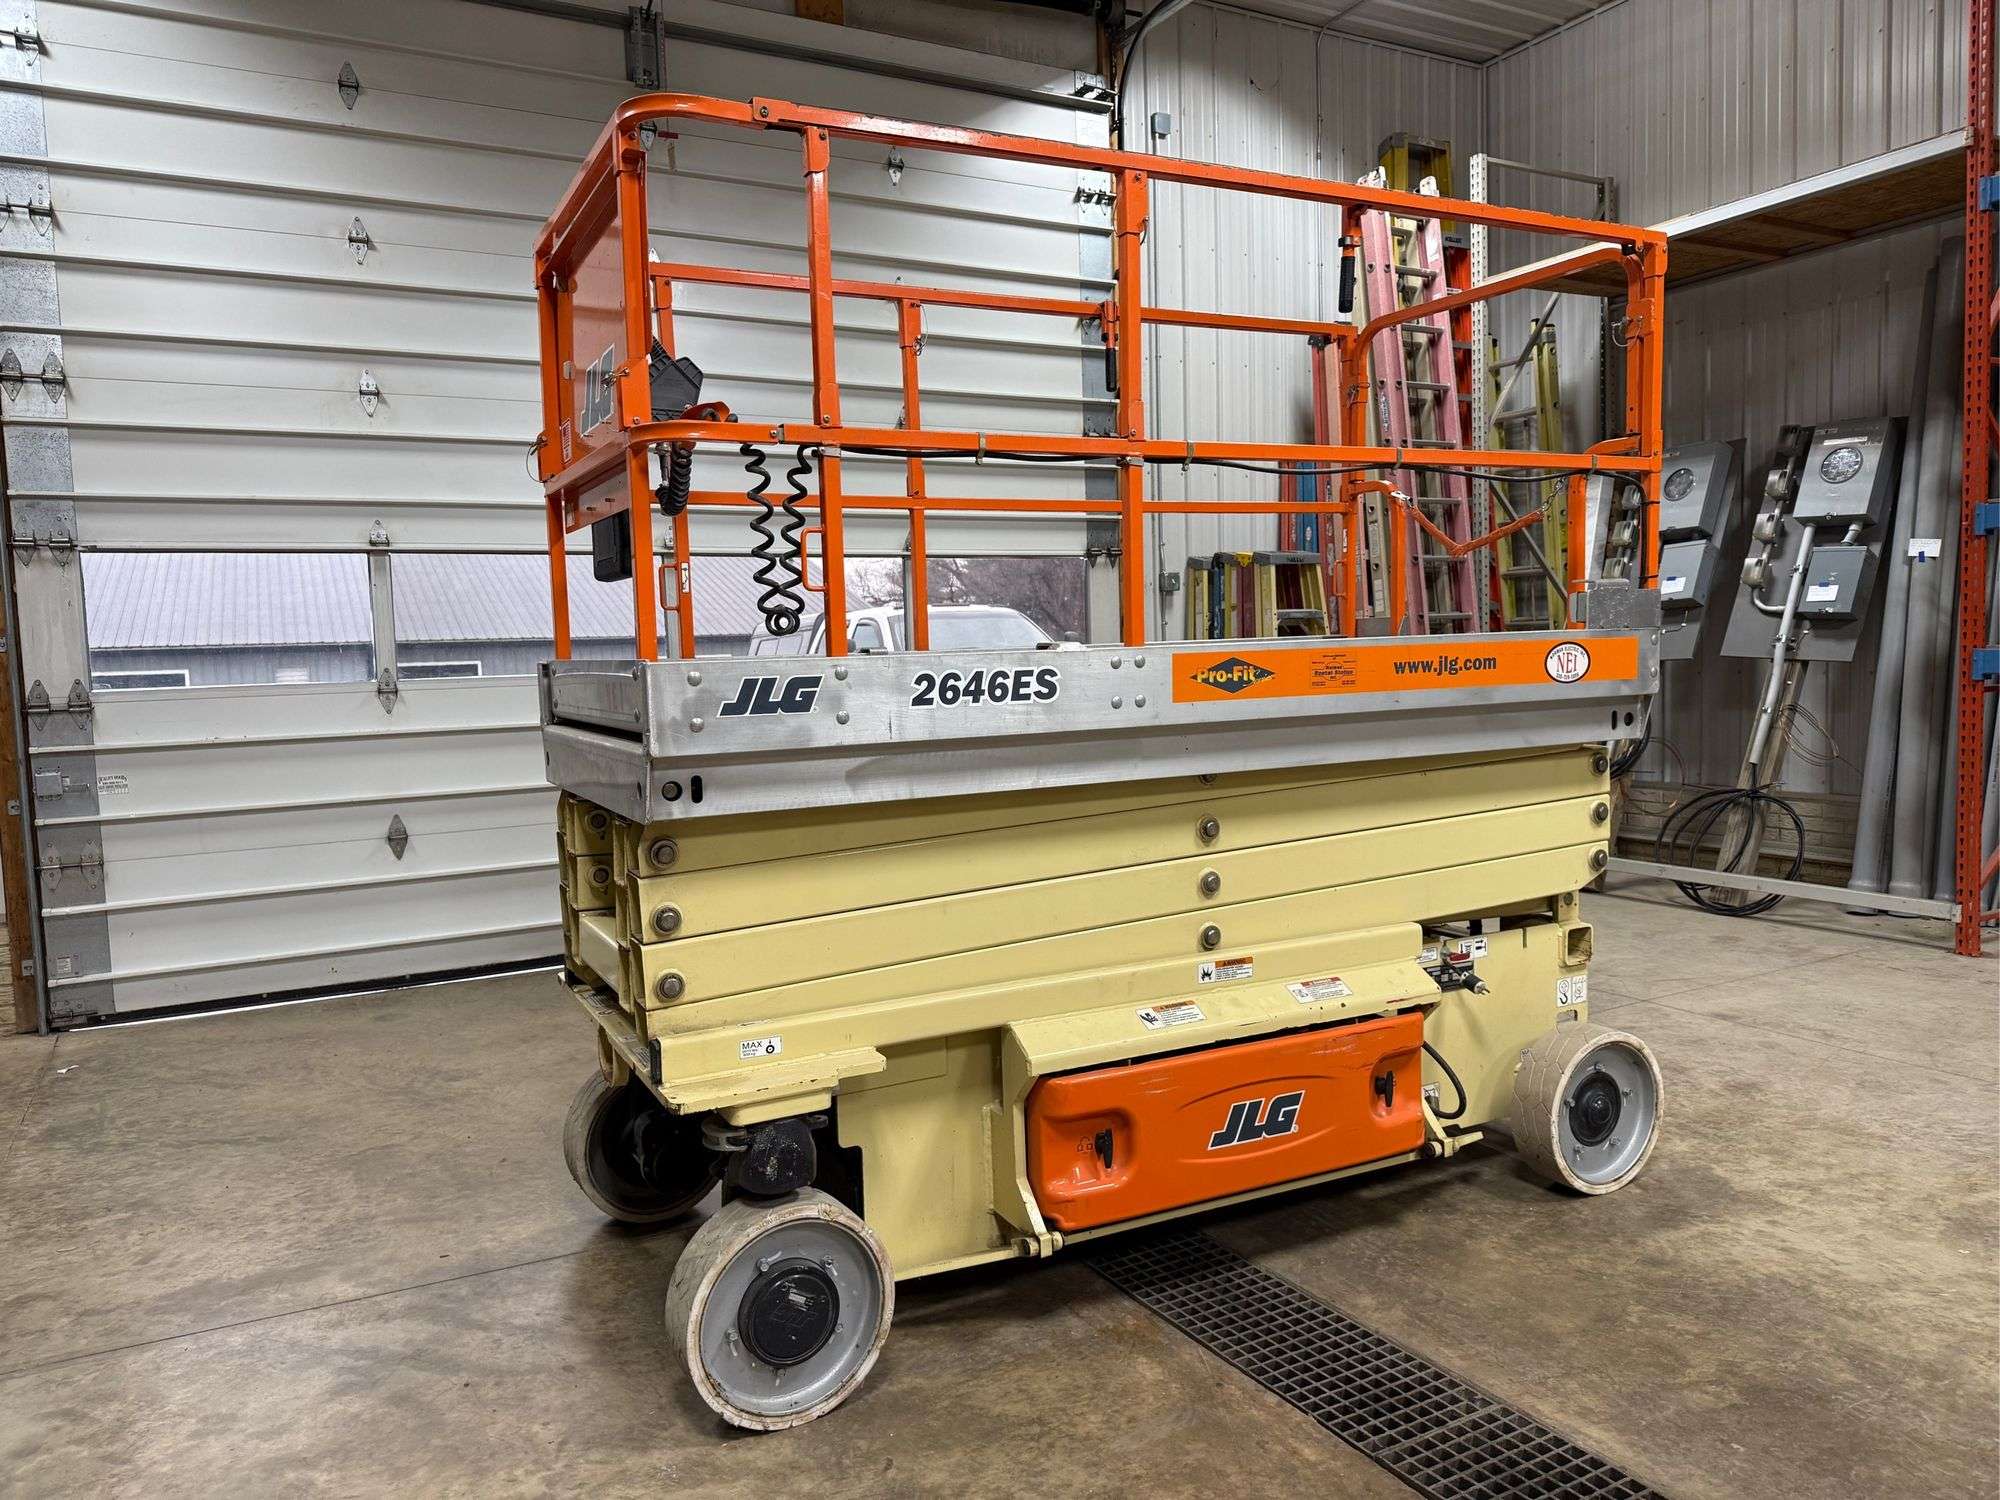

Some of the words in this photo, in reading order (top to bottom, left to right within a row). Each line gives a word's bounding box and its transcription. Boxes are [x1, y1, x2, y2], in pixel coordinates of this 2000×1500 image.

[1393, 655, 1497, 676] www.jlg.com
[1556, 652, 1577, 674] NEI
[1196, 665, 1257, 684] Pro-Fit
[718, 674, 824, 717] JLG
[910, 667, 1059, 706] 2646ES
[742, 1041, 762, 1050] MAX
[1208, 1090, 1306, 1151] JLG
